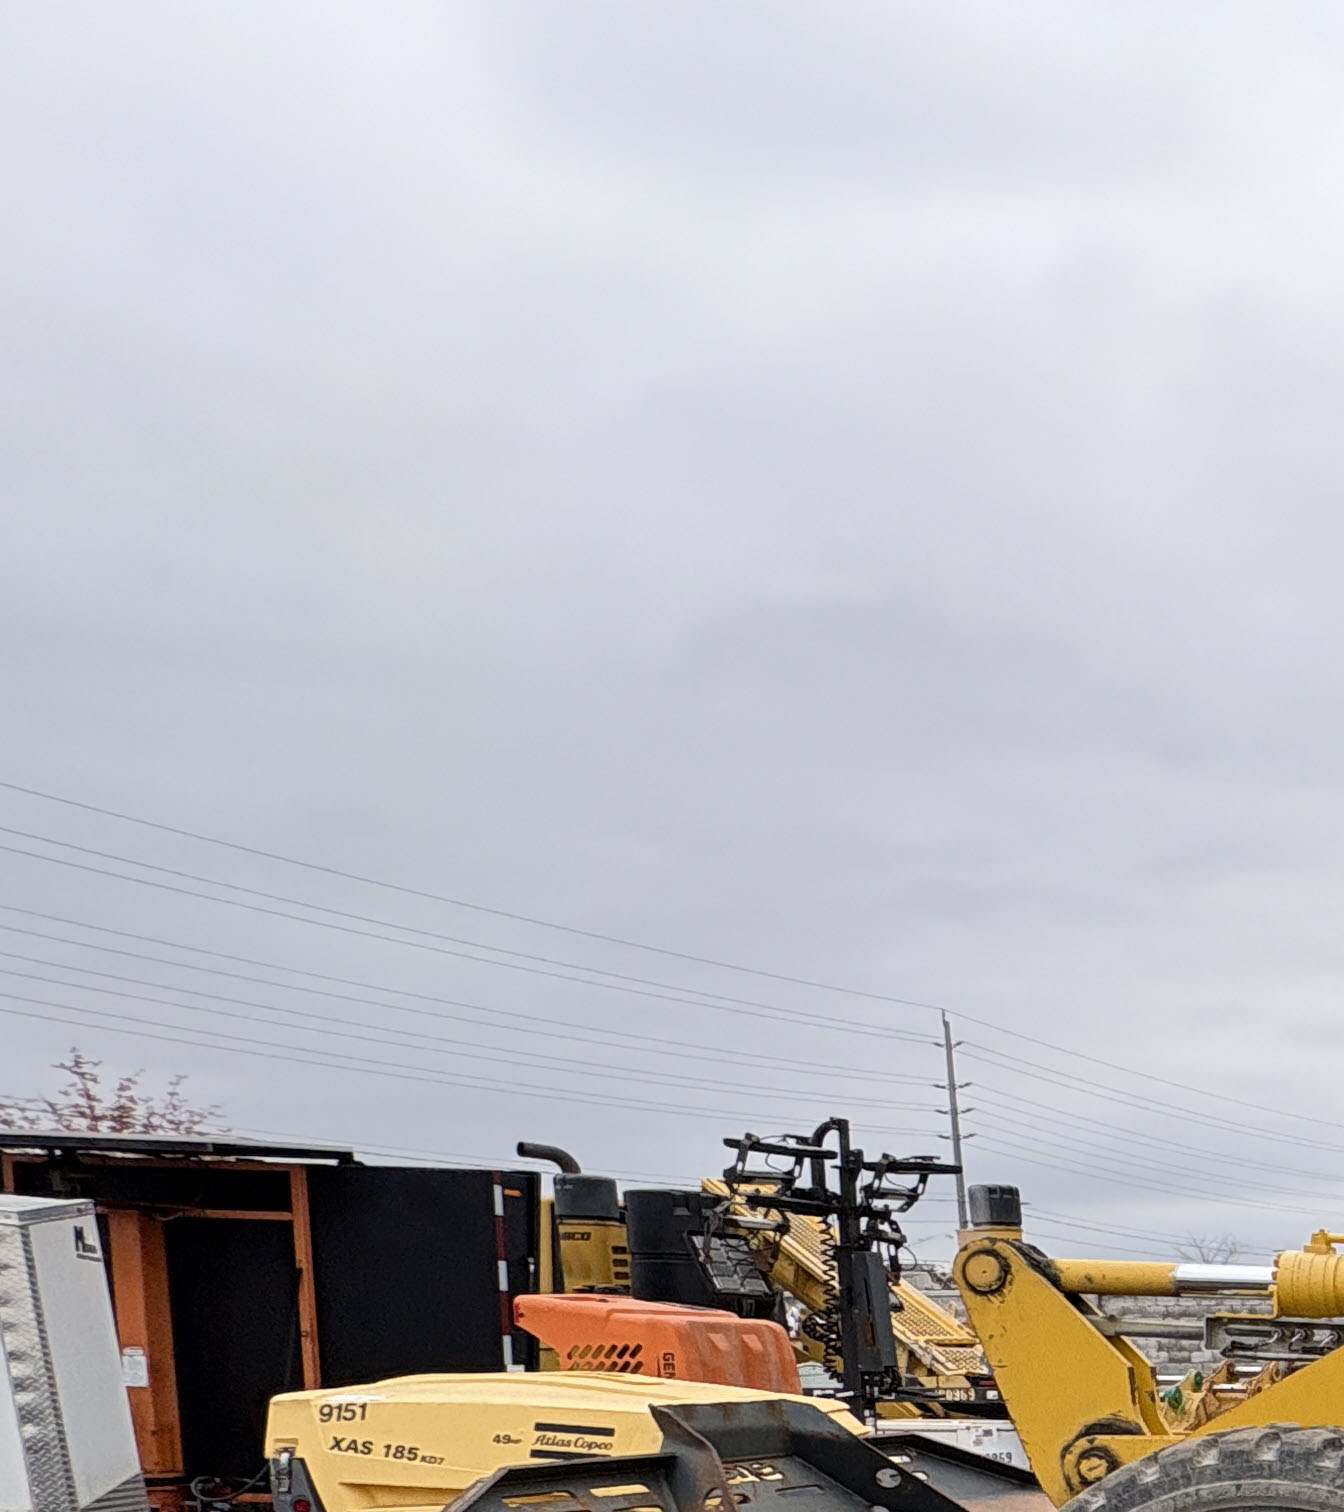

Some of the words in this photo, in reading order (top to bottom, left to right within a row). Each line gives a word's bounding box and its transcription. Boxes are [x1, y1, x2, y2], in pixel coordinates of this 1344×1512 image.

[319, 1402, 368, 1423] 9151
[329, 1436, 374, 1456] XAS
[383, 1443, 420, 1462] 185
[532, 1434, 572, 1448] Atlas
[574, 1436, 614, 1451] Copco
